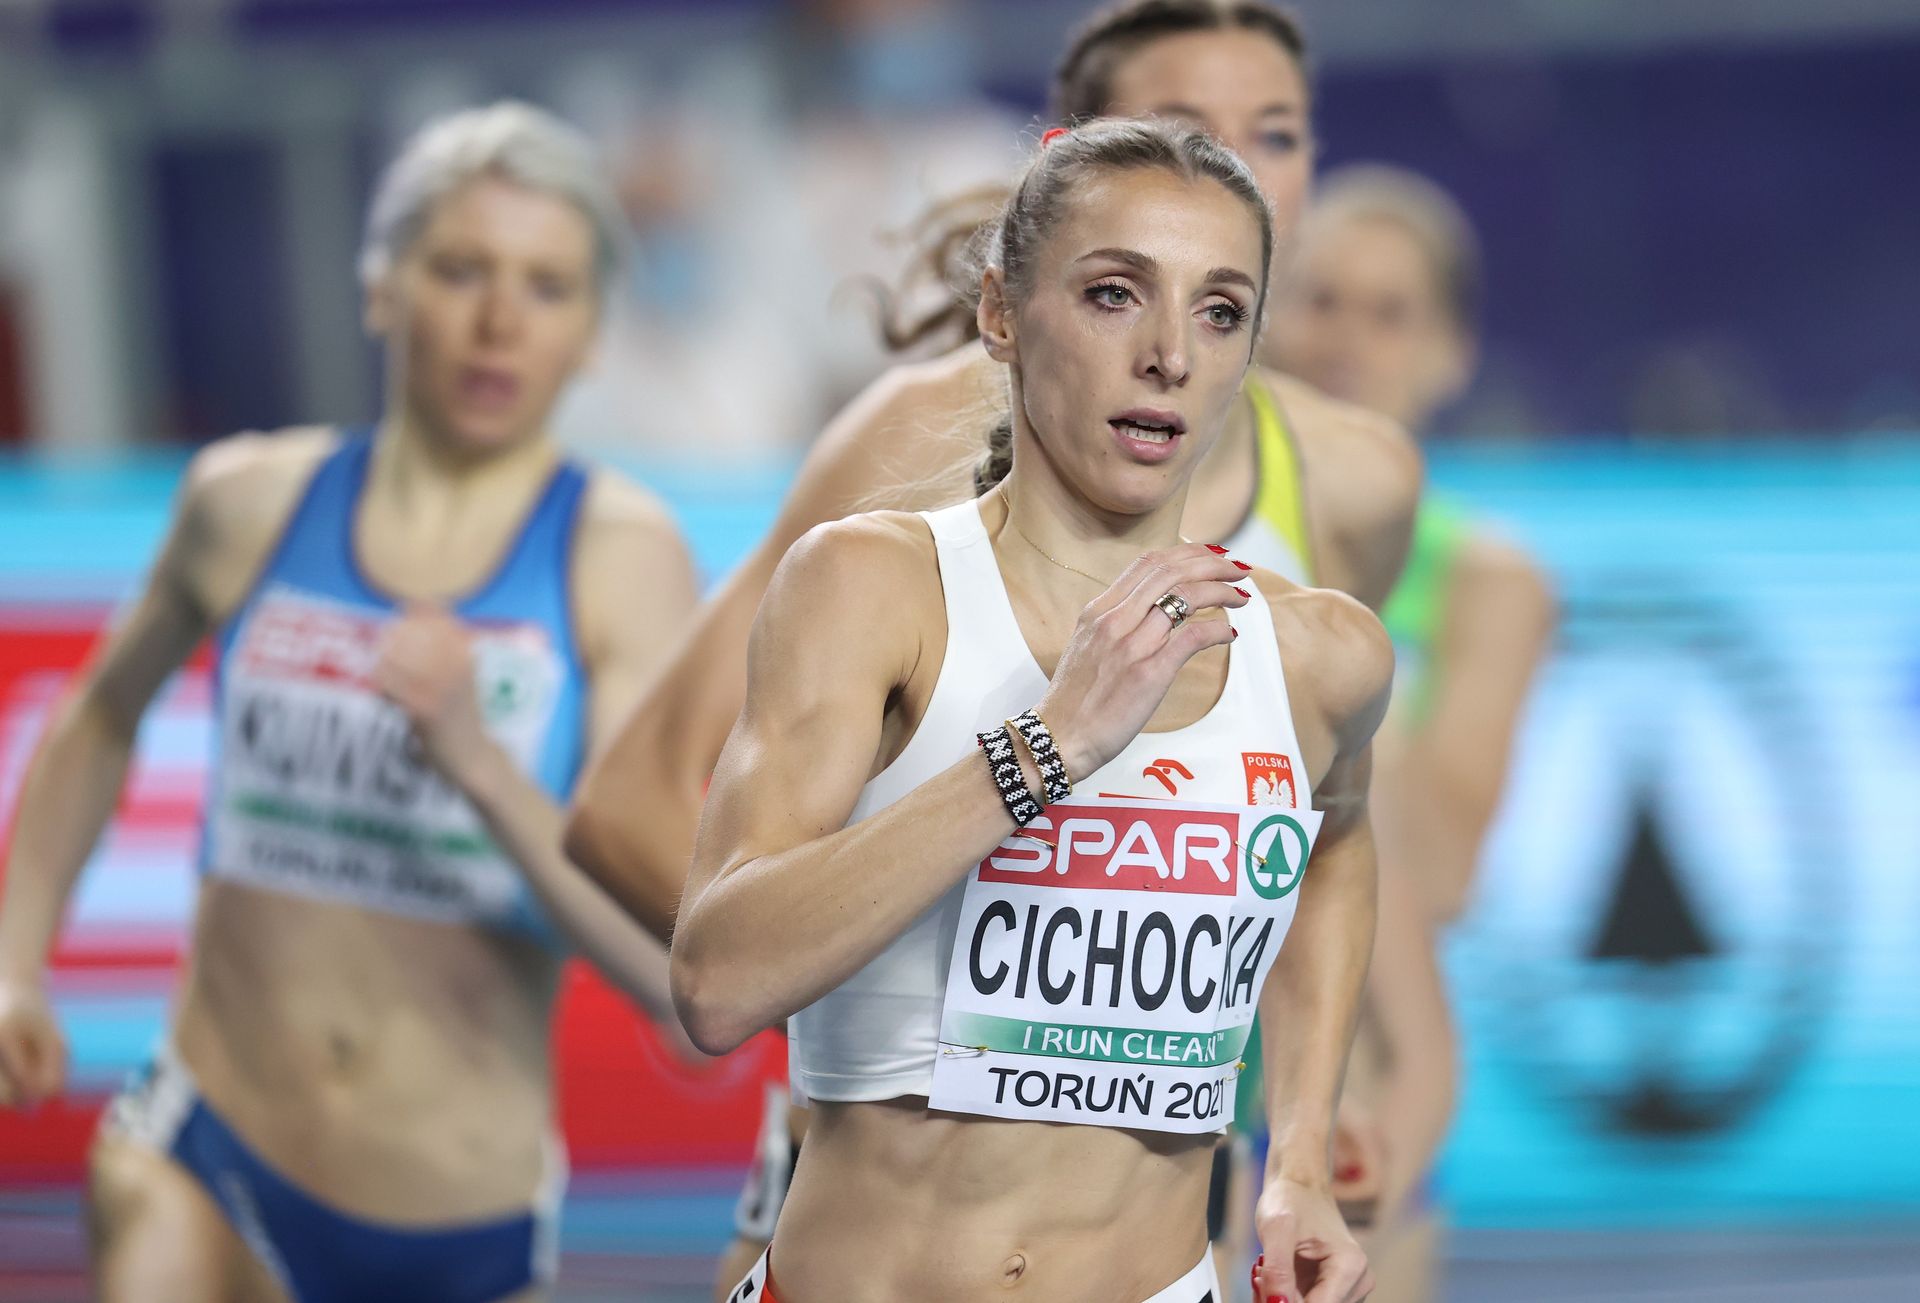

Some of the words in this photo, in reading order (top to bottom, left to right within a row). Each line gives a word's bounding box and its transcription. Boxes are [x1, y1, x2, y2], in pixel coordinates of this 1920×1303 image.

[1247, 755, 1291, 770] POLSKA
[990, 817, 1231, 883] SPAR
[968, 899, 1275, 1014] CICHOCKA
[1022, 1025, 1034, 1051] I
[1042, 1027, 1113, 1056] RUN
[987, 1066, 1154, 1116] TORUŃ
[1164, 1076, 1225, 1120] 2021
